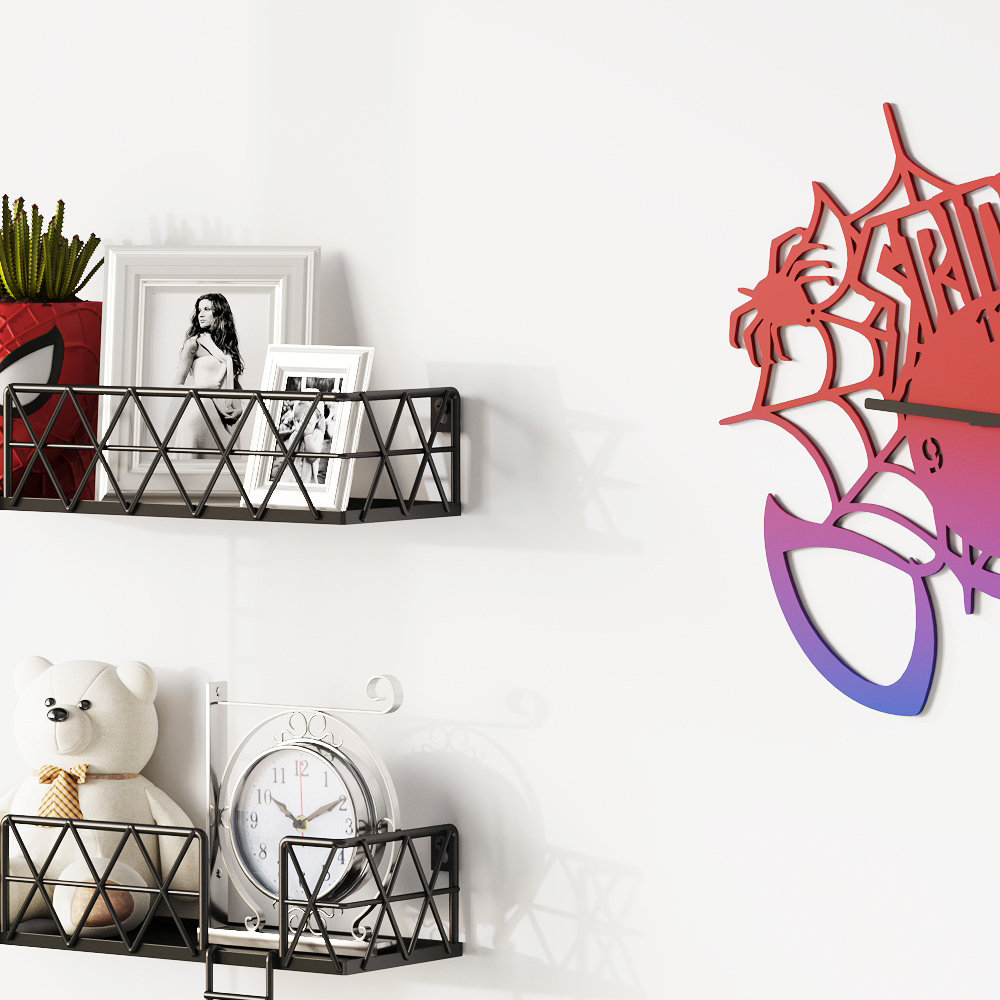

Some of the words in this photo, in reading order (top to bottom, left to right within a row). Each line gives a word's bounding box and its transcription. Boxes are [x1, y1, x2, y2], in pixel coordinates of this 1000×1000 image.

[975, 303, 1000, 343] 1
[921, 437, 944, 474] 9
[273, 767, 286, 784] 11
[294, 760, 309, 777] 12
[323, 771, 329, 788] 1
[257, 788, 272, 806] 10
[338, 794, 348, 811] 2
[250, 811, 259, 829] 9
[345, 818, 354, 835] 3
[259, 842, 268, 860] 8
[337, 847, 346, 865] 4
